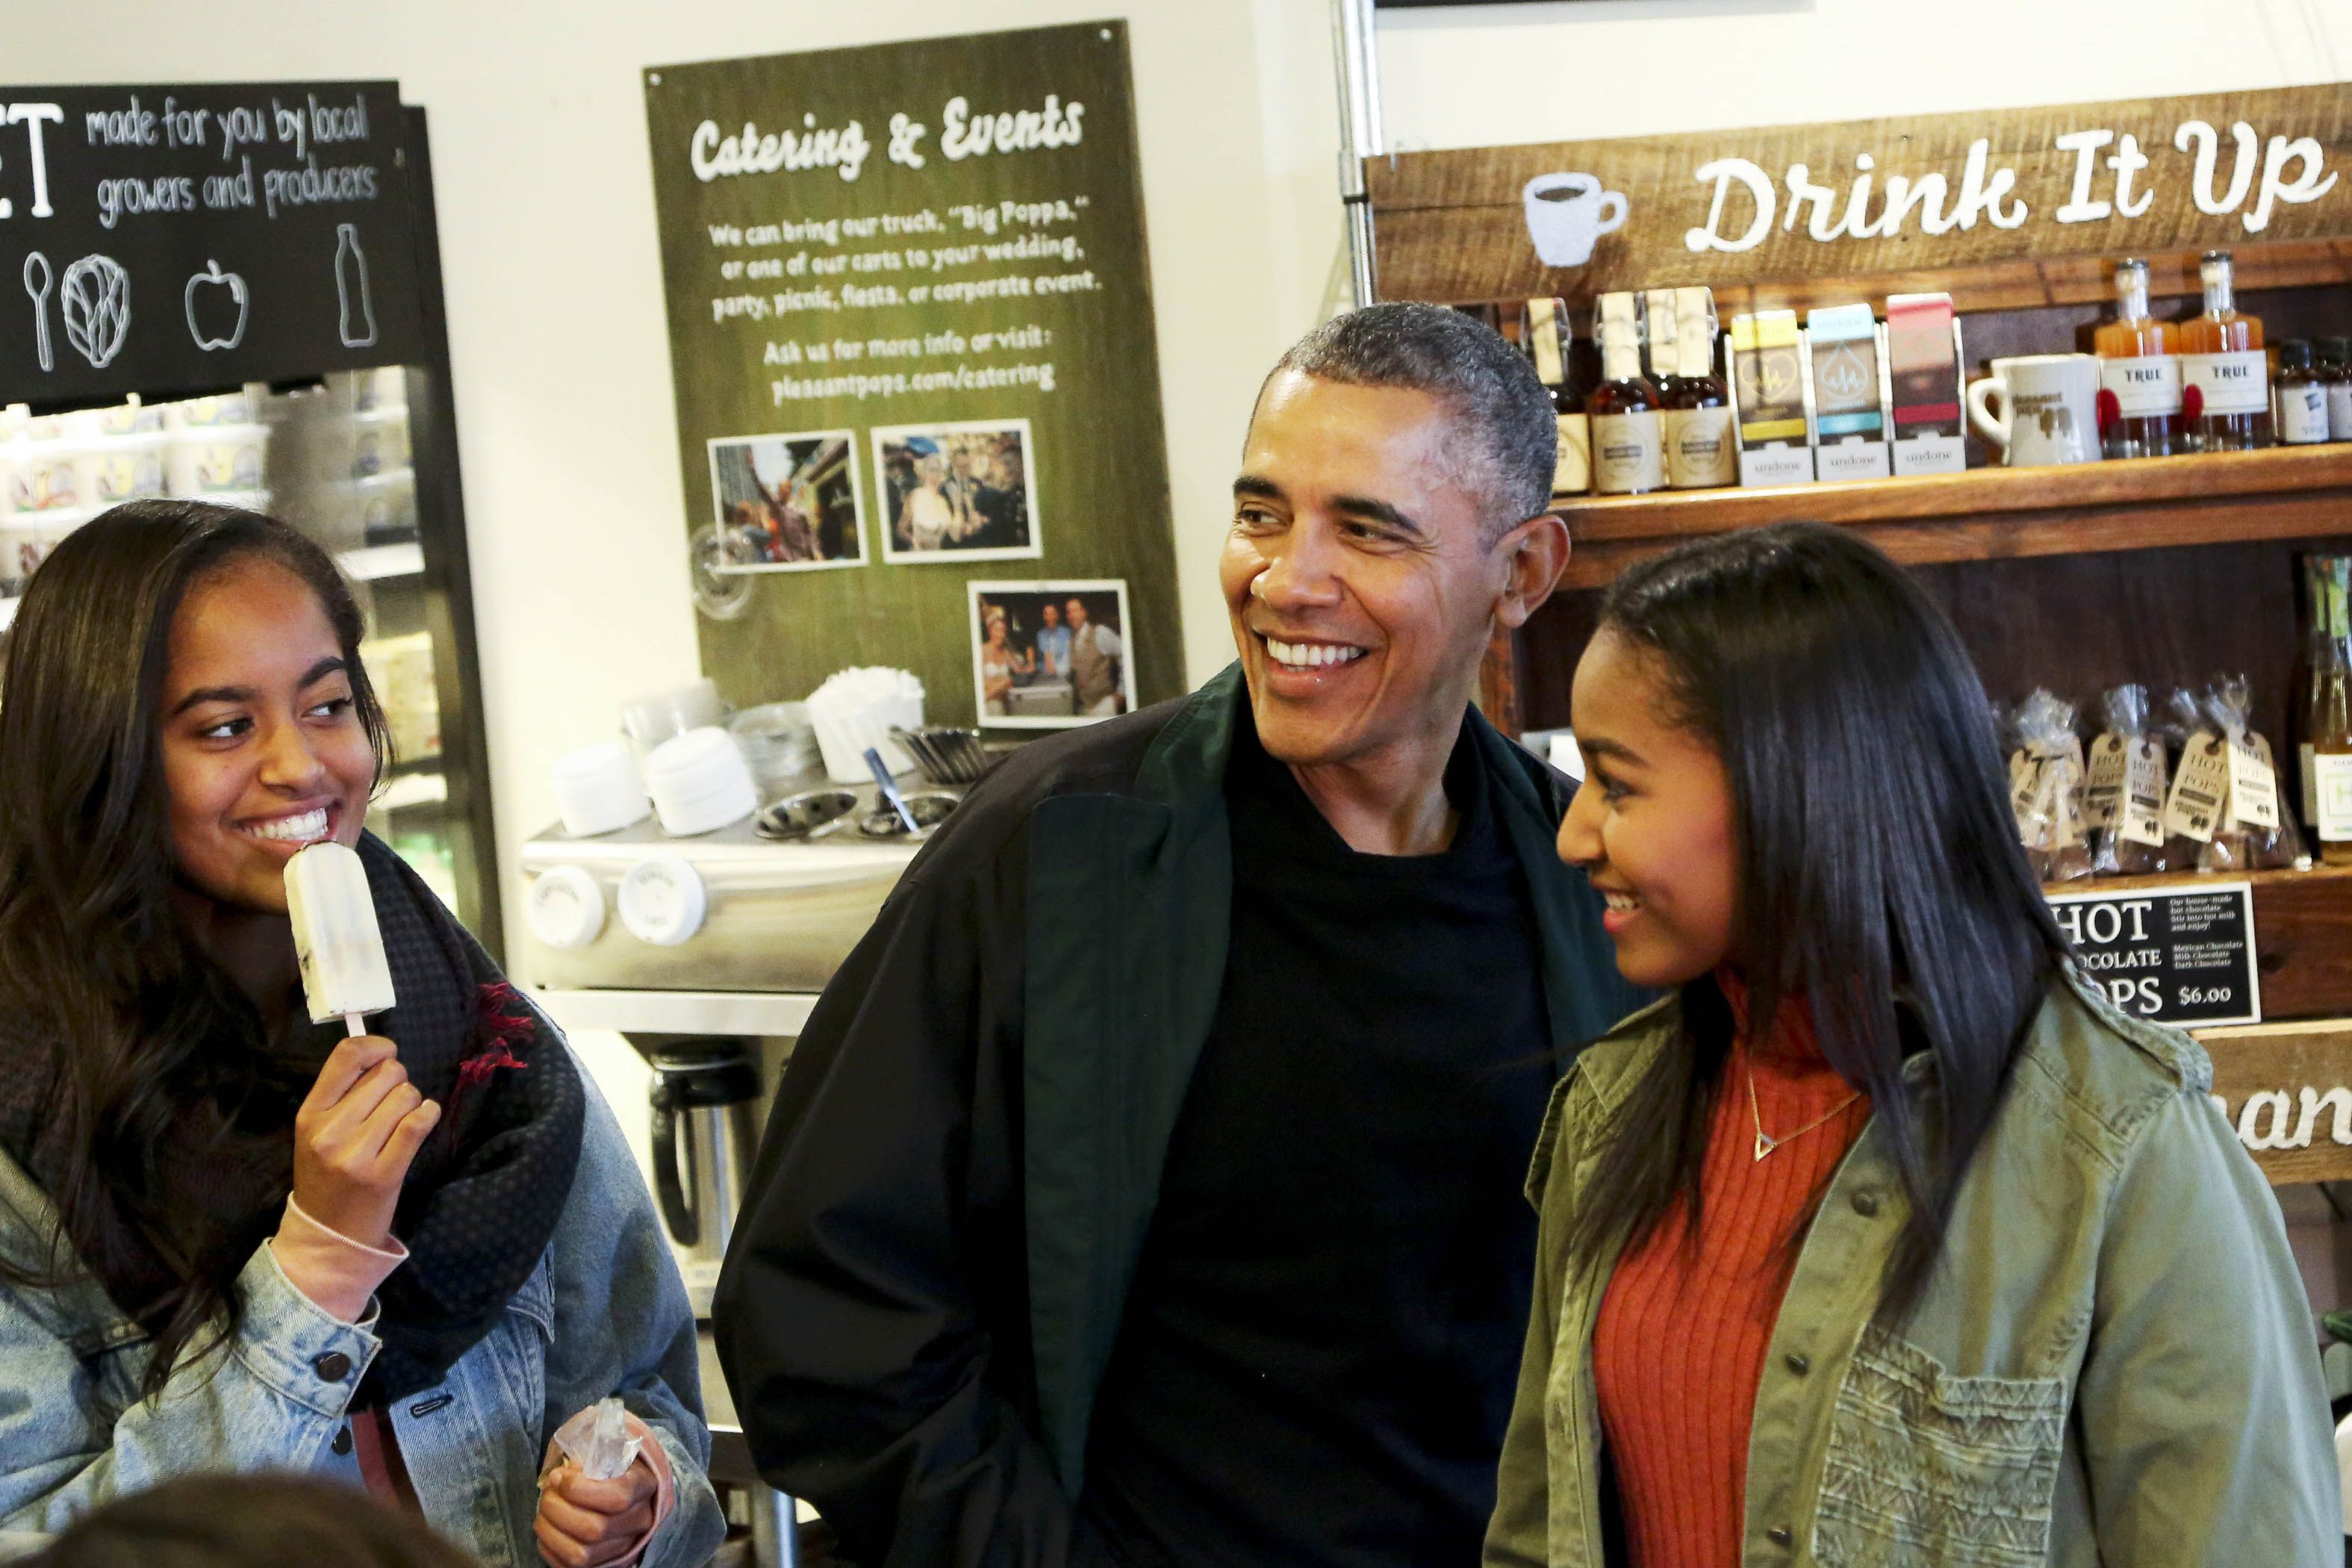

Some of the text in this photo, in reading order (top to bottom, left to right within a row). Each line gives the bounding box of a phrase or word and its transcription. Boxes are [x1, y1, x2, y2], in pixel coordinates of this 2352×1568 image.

[86, 93, 370, 161] made for you by local
[691, 94, 1085, 181] Catering & Events
[0, 103, 64, 219] T
[97, 152, 379, 229] growers and producers
[1683, 119, 2339, 253] Drink It Up
[709, 223, 742, 247] We
[746, 225, 783, 246] can
[783, 218, 839, 246] bring
[842, 217, 878, 237] our
[721, 232, 1085, 280] or one of our carts to your wedding,
[909, 285, 930, 304] or
[933, 275, 1033, 304] corporate
[763, 340, 801, 365] Ask
[806, 342, 829, 363] us
[833, 337, 864, 360] for
[868, 337, 921, 358] more
[924, 329, 966, 355] info
[971, 332, 994, 353] or
[2124, 367, 2163, 382] TRUE
[2212, 364, 2250, 379] TRUE
[771, 363, 1057, 408] pleasantpops.com/catering
[1830, 455, 1877, 467] undone
[1905, 450, 1952, 462] undone
[2190, 753, 2224, 774] HOT
[2185, 904, 2222, 912] chocolate
[2204, 912, 2217, 921] hot
[2218, 911, 2236, 920] milk
[2050, 900, 2152, 945] HOT
[2171, 924, 2186, 932] and
[2174, 941, 2244, 953] Mexican Chocolate
[2174, 951, 2230, 961] Milk Chocolate
[2174, 959, 2232, 969] Dark Chocolate
[2178, 986, 2232, 1007] $6.00
